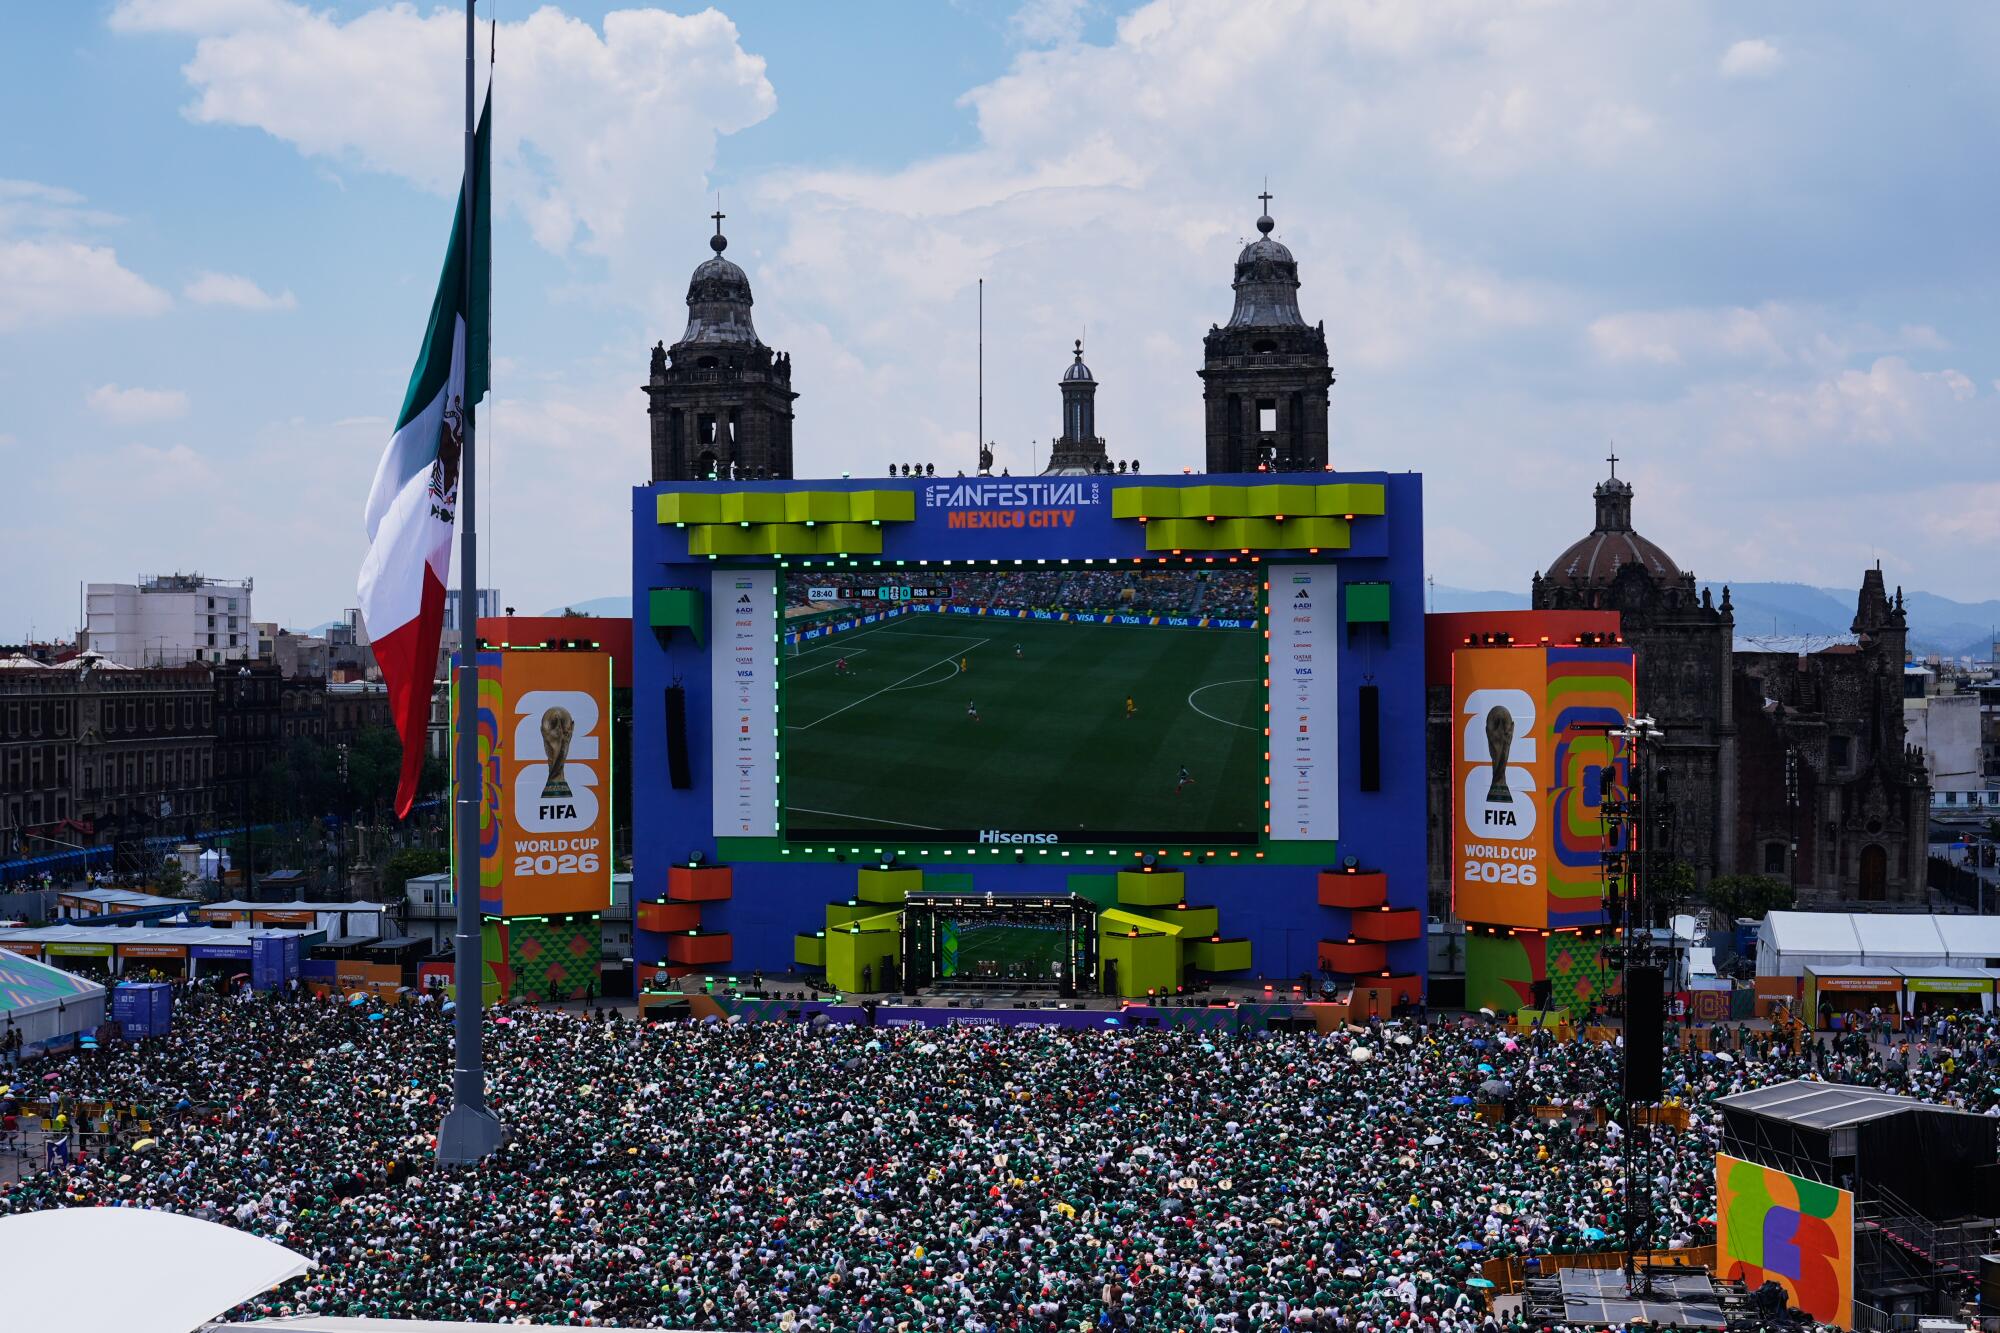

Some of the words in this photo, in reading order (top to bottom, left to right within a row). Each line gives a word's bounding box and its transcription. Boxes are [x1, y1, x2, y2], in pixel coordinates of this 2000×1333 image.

[926, 485, 934, 507] FIFA
[948, 511, 1025, 529] MEXICO
[1029, 510, 1076, 528] CITY
[811, 590, 832, 598] 28:40
[861, 589, 876, 597] MEX
[903, 589, 908, 597] 0
[913, 588, 928, 597] RSA
[913, 604, 930, 612] VISA
[953, 606, 970, 614] VISA
[993, 608, 1010, 617] VISA
[864, 614, 876, 624] VISA
[1034, 611, 1053, 619] VISA
[1076, 613, 1095, 622] VISA
[1121, 616, 1140, 624] VISA
[1168, 617, 1188, 626] VISA
[1218, 619, 1240, 628] VISA
[837, 622, 850, 632] VISA
[805, 629, 820, 639] VISA
[539, 804, 577, 820] FIFA
[1485, 809, 1517, 826] FIFA
[979, 829, 1058, 844] Hisense
[514, 840, 569, 854] WORLD
[570, 838, 600, 852] CUP
[1464, 844, 1510, 860] WORLD
[1511, 847, 1537, 862] CUP
[514, 853, 600, 877] 2026
[1464, 860, 1537, 886] 2026
